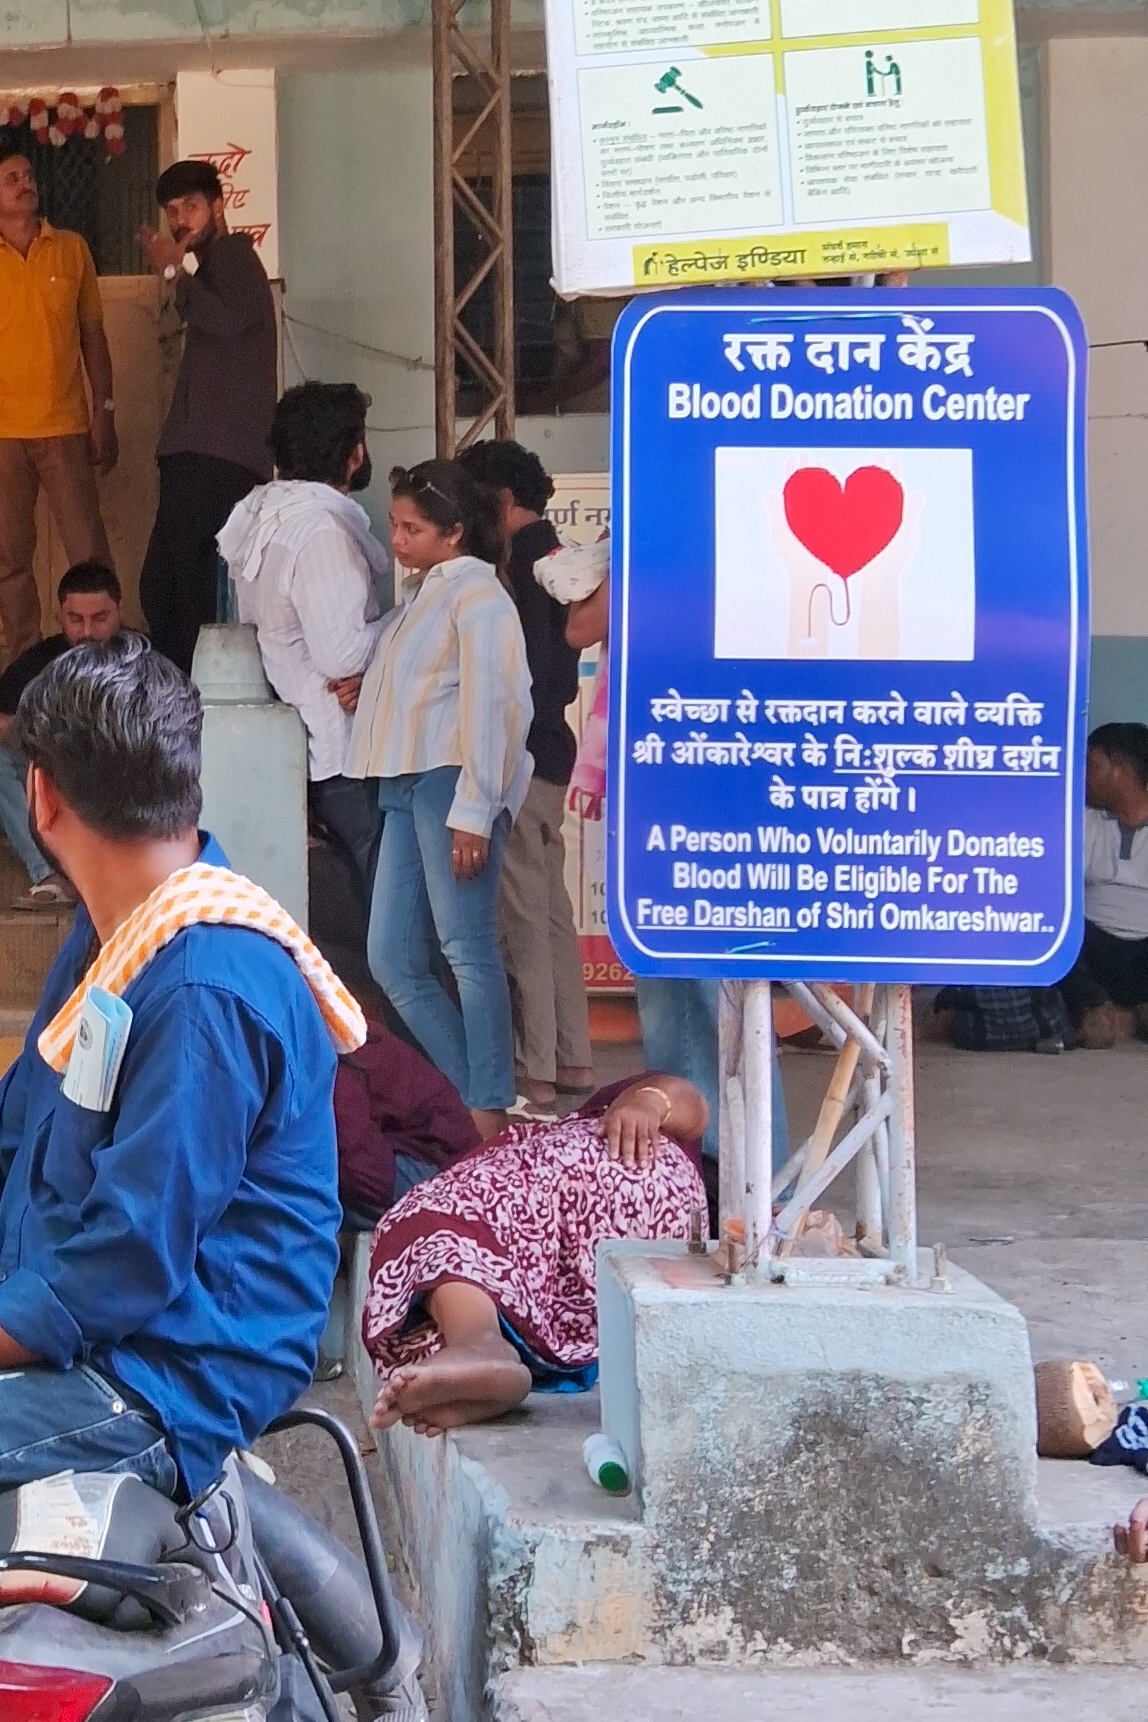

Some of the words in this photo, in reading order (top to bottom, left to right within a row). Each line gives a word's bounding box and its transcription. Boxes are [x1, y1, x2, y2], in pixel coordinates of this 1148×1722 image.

[722, 333, 795, 372] रक्त
[804, 333, 887, 375] दान
[896, 318, 976, 377] केंद्र
[667, 383, 761, 420] Blood
[771, 383, 913, 420] Donation
[921, 384, 1031, 421] Center
[650, 688, 731, 723] स्वेच्छा
[735, 689, 759, 724] से
[764, 700, 847, 726] रक्तदान
[852, 690, 908, 725] करने
[913, 690, 969, 726] वाले
[973, 692, 1045, 727] व्यक्ति
[632, 732, 665, 765] श्री
[671, 731, 796, 767] ओंकारेश्वर
[801, 732, 828, 767] के
[942, 736, 998, 771] शीघ्र
[1002, 735, 1062, 772] दर्शन
[768, 774, 796, 810] के
[800, 786, 849, 811] पात्र
[853, 776, 901, 814] होंगे
[646, 824, 666, 852] A
[670, 825, 752, 853] Person
[757, 826, 812, 854] Who
[816, 827, 942, 863] Voluntarily
[947, 829, 1045, 858] Donates
[673, 862, 742, 889] Blood
[746, 863, 791, 891] Will
[796, 864, 829, 891] Be
[834, 864, 922, 899] Eligible
[927, 866, 969, 894] For
[973, 867, 1019, 895] The
[637, 898, 689, 926] Free
[694, 899, 791, 927] Darshan
[796, 901, 822, 929] of
[825, 902, 875, 930] Shri
